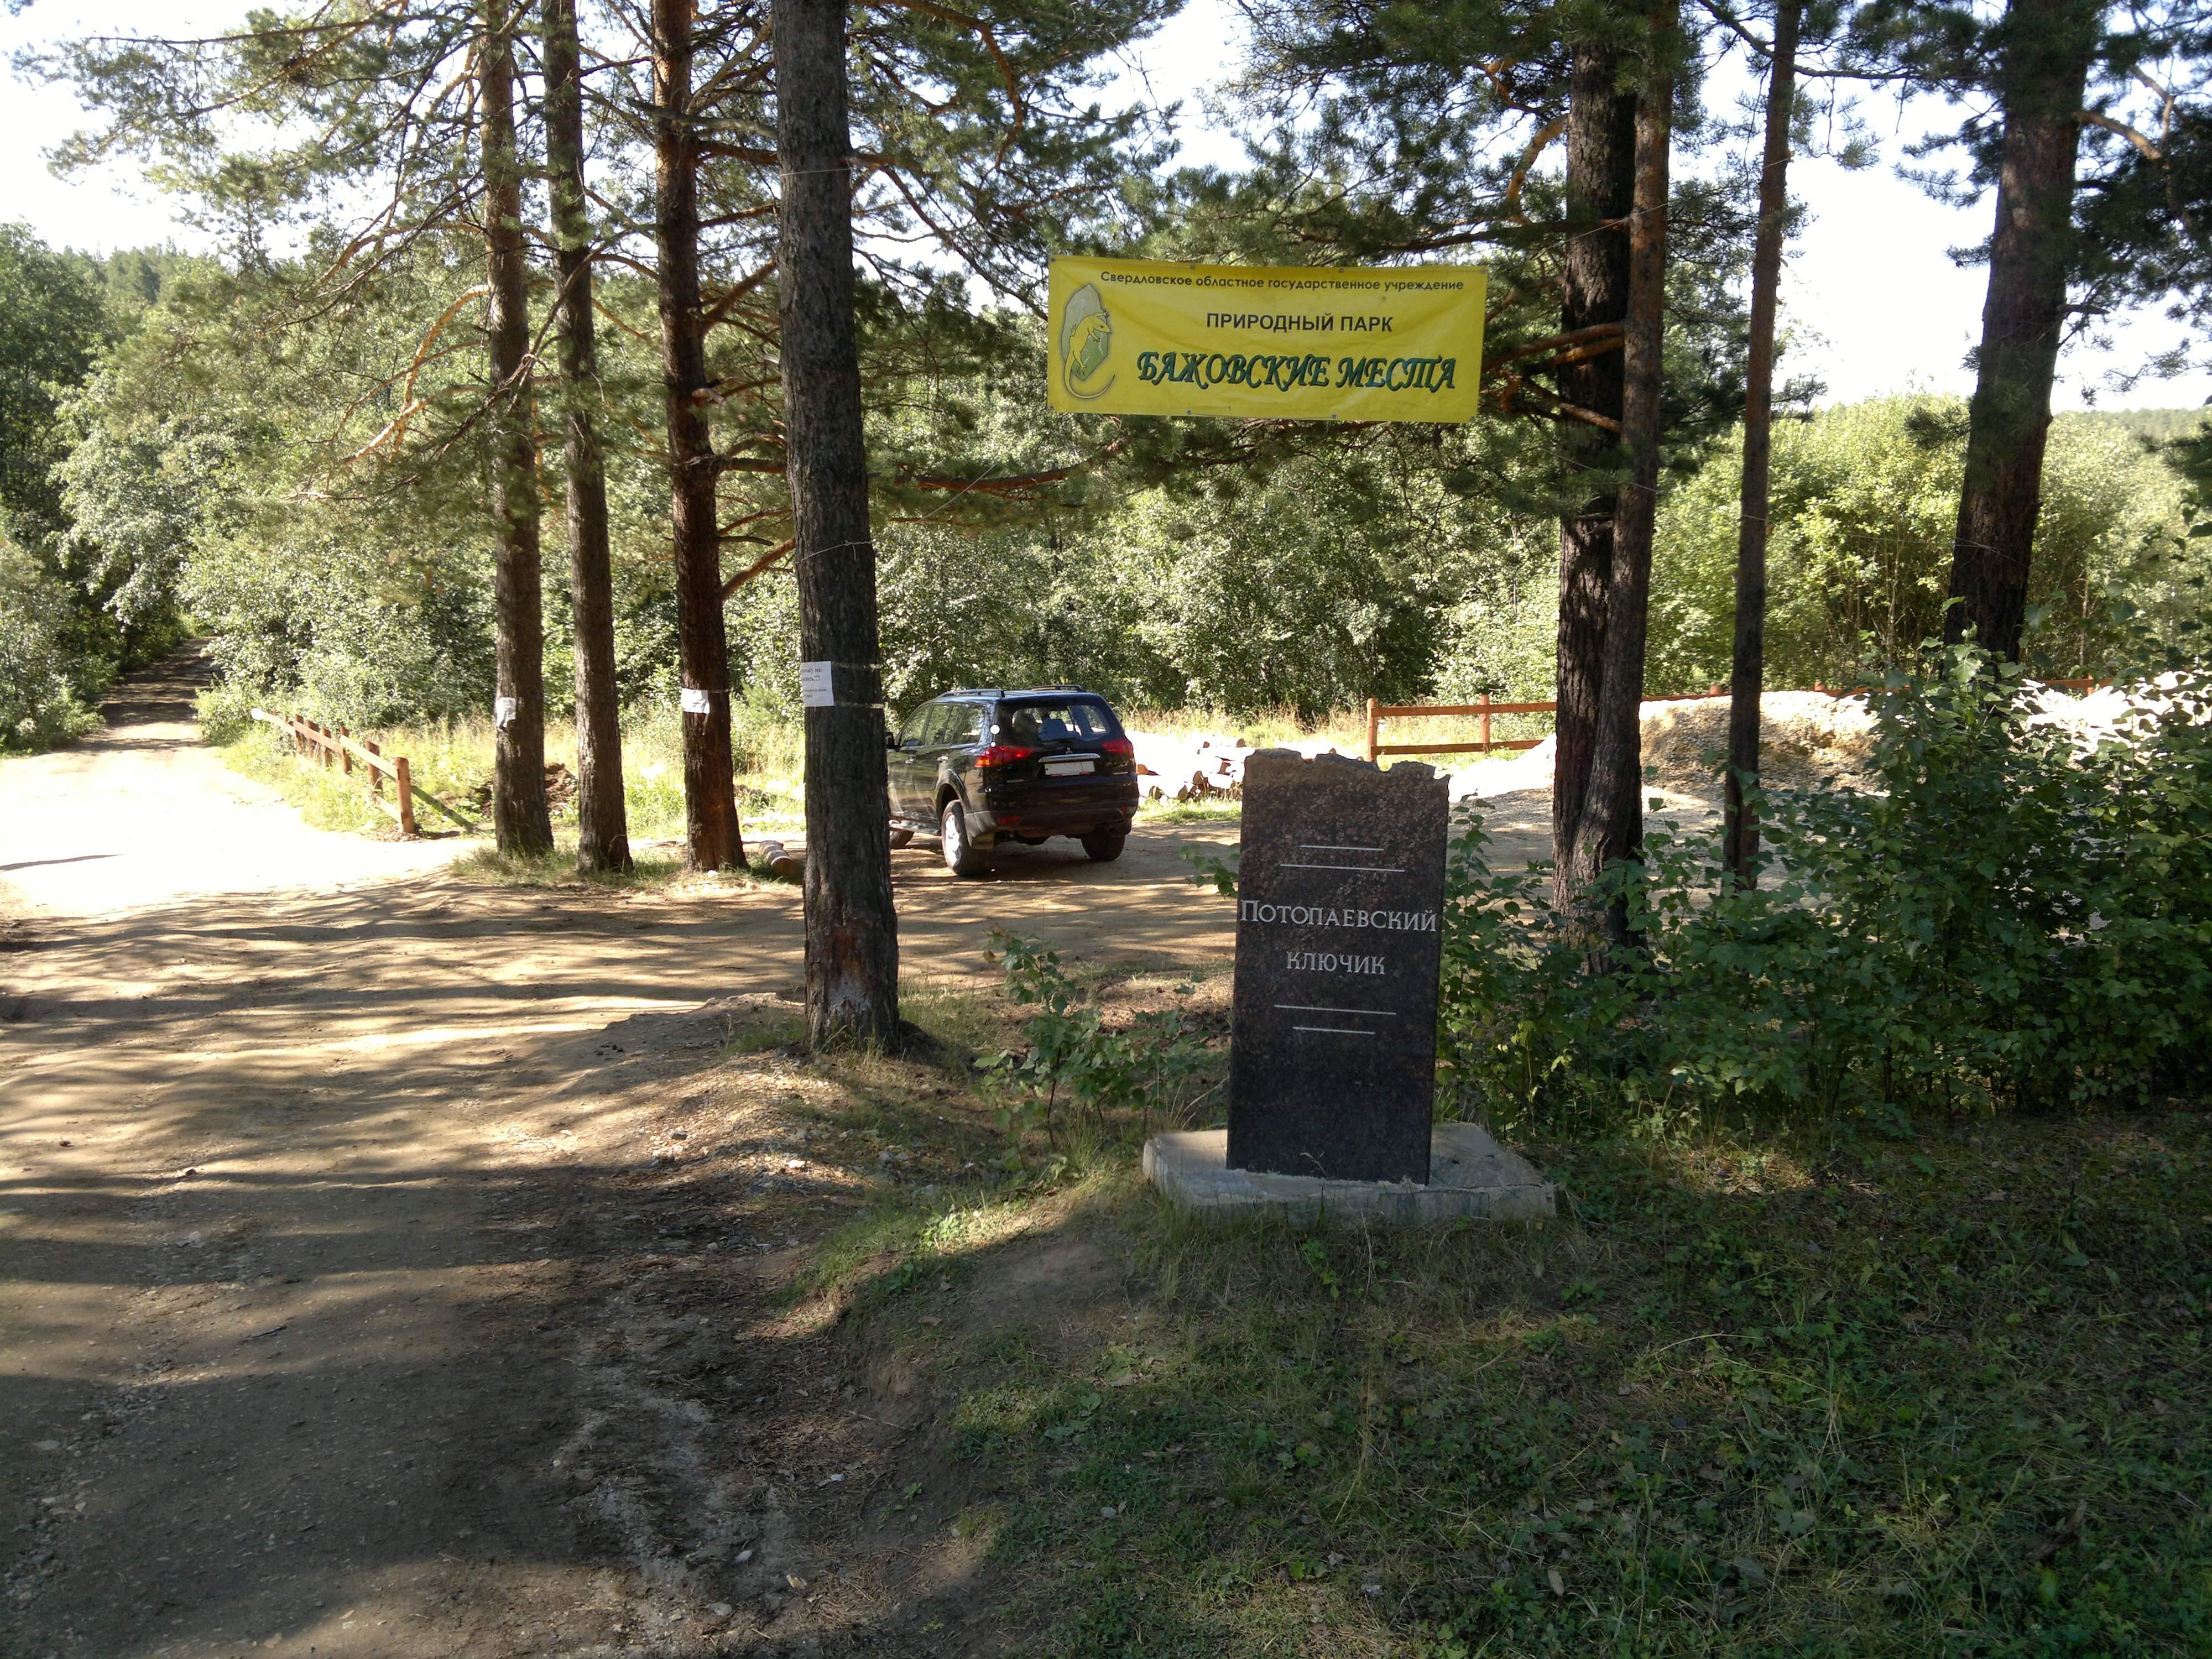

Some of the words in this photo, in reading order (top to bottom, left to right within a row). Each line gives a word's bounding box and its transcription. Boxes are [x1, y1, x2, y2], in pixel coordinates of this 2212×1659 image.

[1100, 271, 1192, 285] Свердловское
[1196, 276, 1264, 288] областное
[1267, 279, 1381, 291] государственное
[1384, 280, 1464, 292] учреждение
[1206, 312, 1334, 333] ПРИРОДНЫЙ
[1340, 316, 1393, 332] ПАРК
[1137, 351, 1330, 392] БАЖОВСКИЕ
[1335, 354, 1457, 393] МЕСТА
[1286, 950, 1385, 974] КЛЮЧИК
